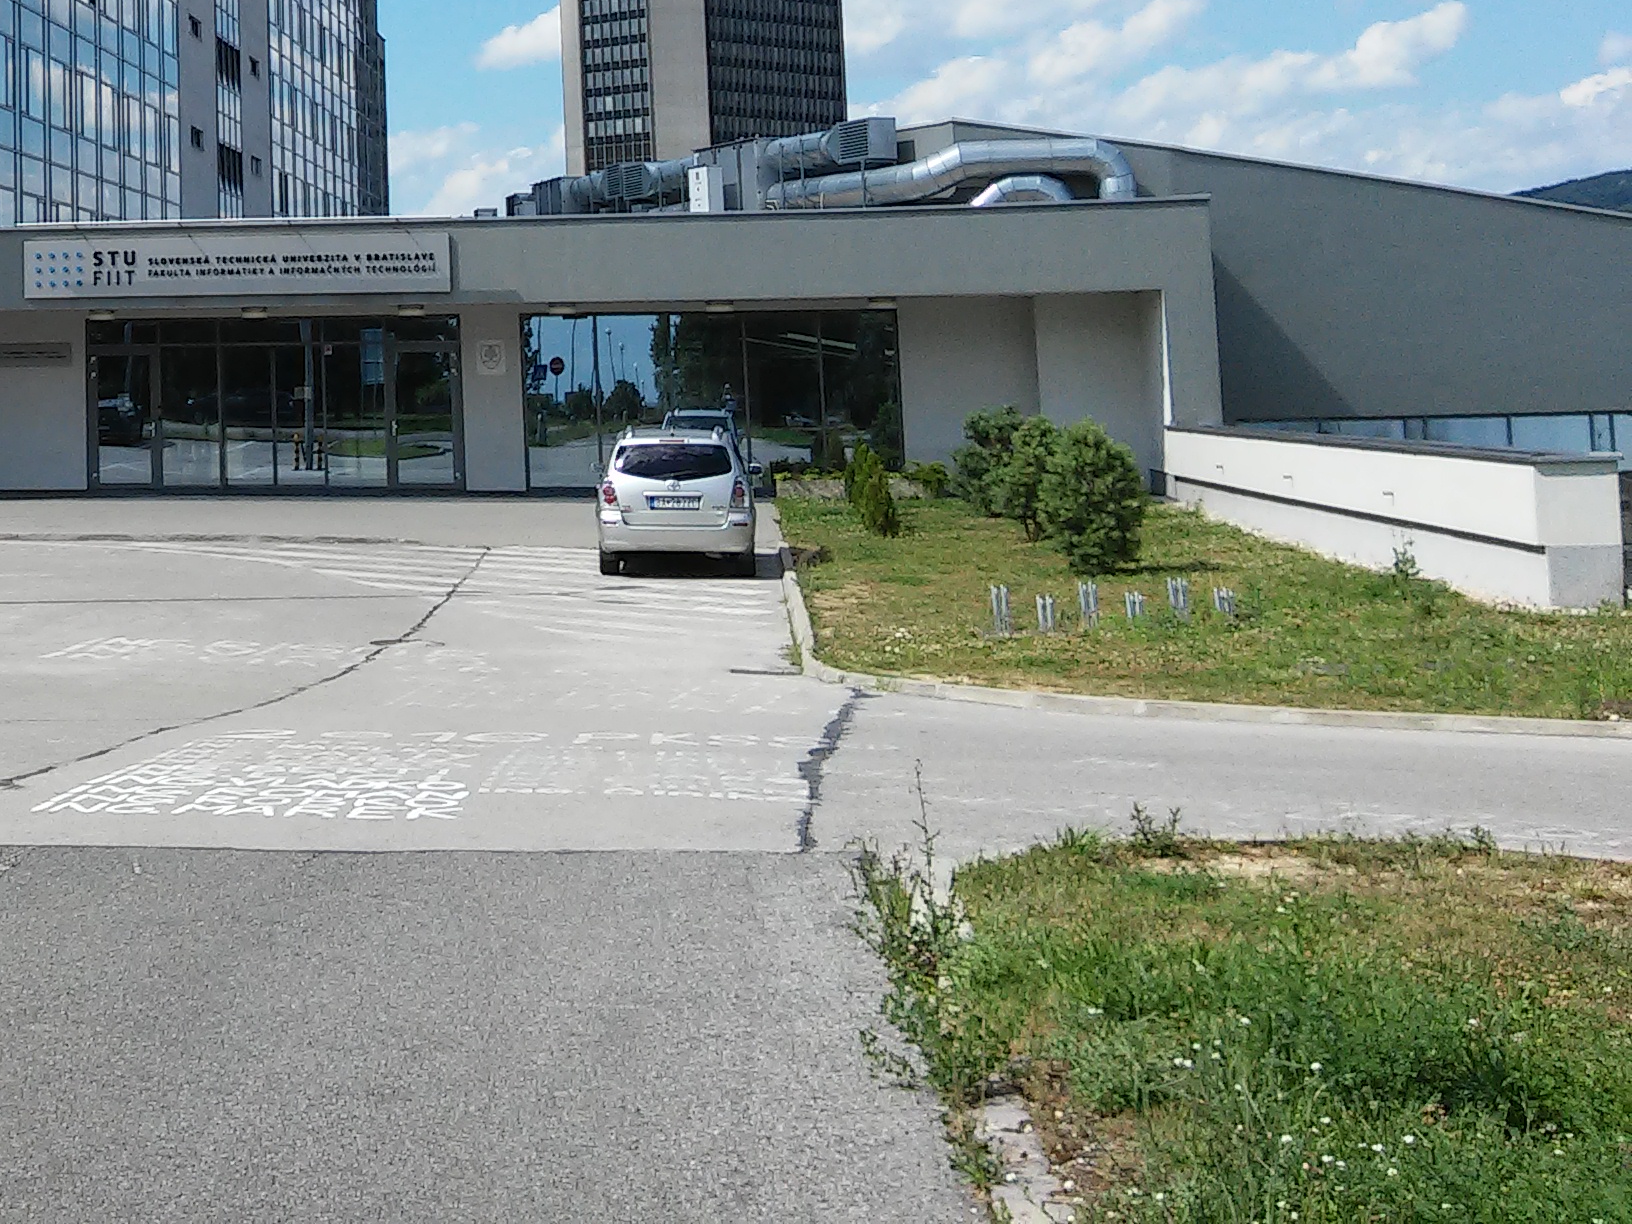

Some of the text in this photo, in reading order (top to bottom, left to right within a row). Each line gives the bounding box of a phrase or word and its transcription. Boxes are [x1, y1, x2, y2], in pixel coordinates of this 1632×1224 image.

[92, 250, 137, 267] STU
[354, 253, 361, 262] V
[366, 252, 436, 262] BRATISLAVE
[92, 269, 136, 286] FIIT
[147, 268, 192, 277] FAKULTA
[195, 267, 266, 277] INFORMATIKY
[268, 266, 276, 276] A
[170, 803, 464, 820] MAREK
